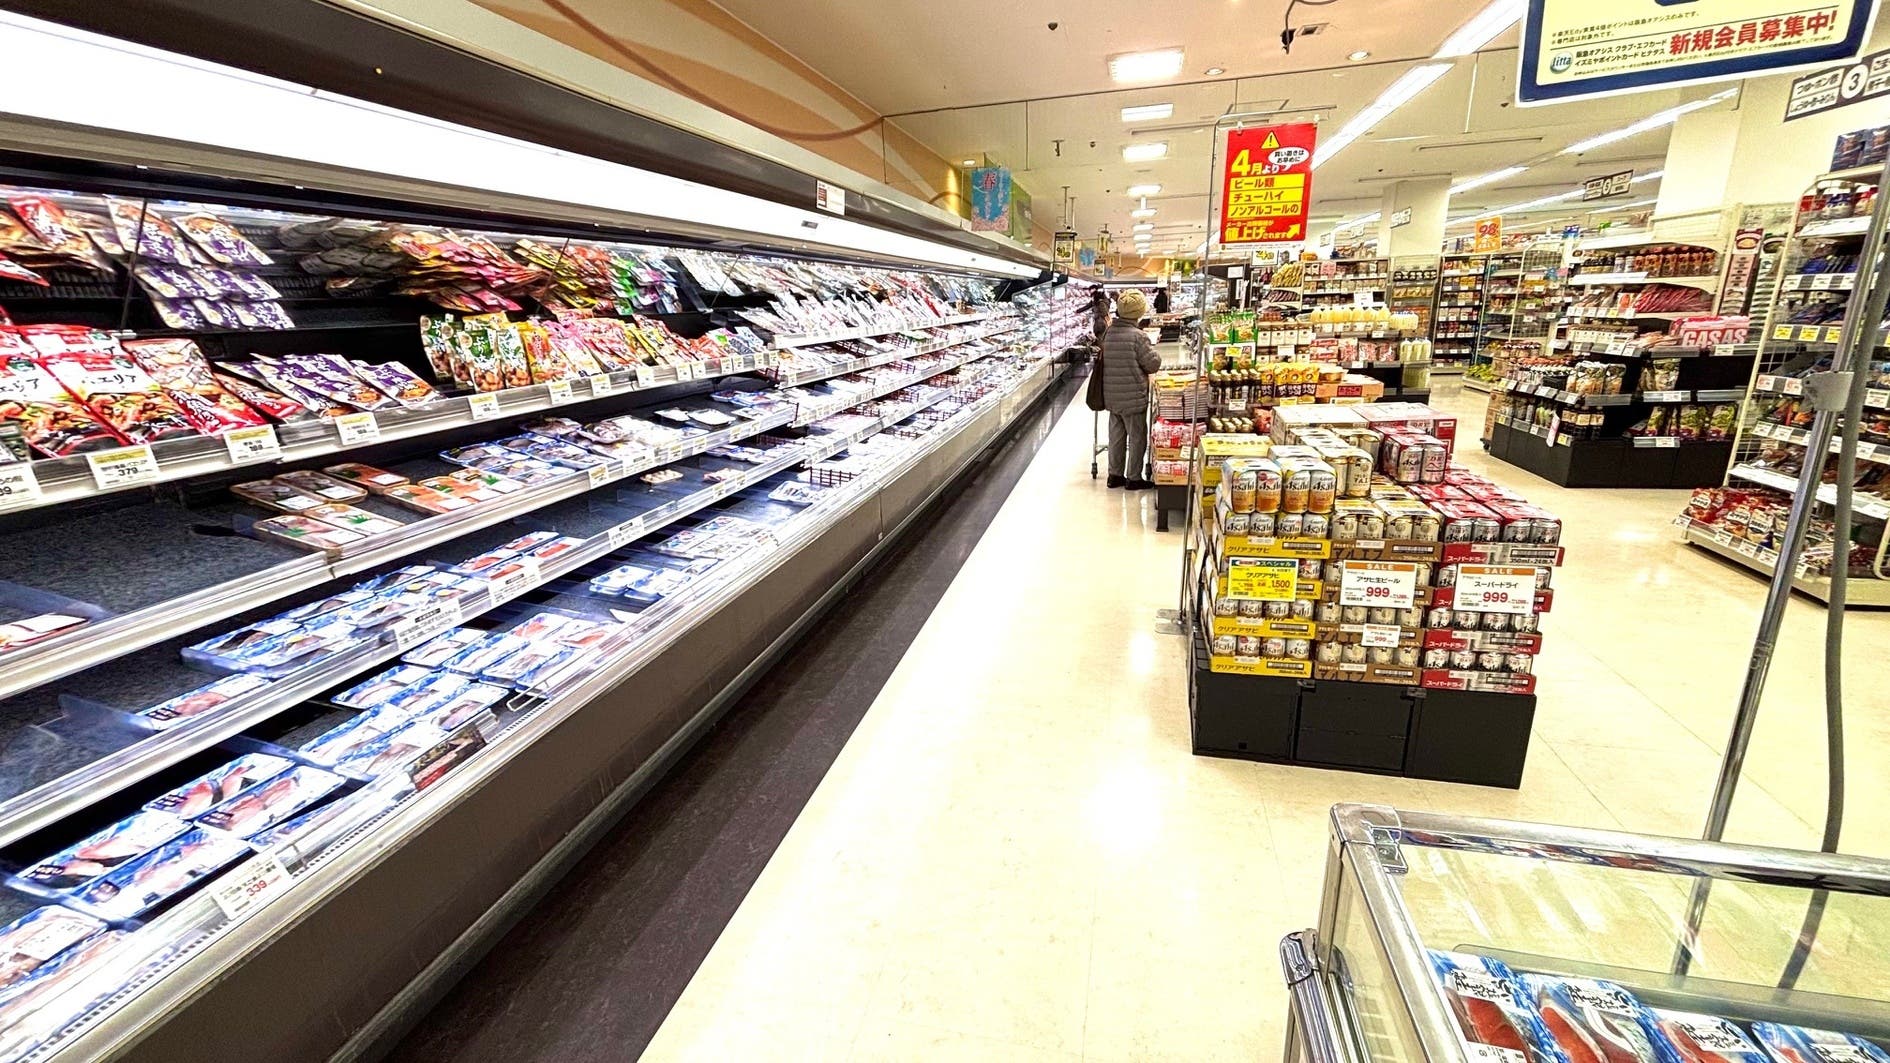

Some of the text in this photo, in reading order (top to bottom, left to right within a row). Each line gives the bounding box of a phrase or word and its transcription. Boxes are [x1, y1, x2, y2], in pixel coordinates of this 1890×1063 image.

[1669, 10, 1837, 55] 新規会員募集中!
[1848, 73, 1860, 91] 3
[1231, 149, 1280, 176] 4月より
[1234, 178, 1275, 189] ビール類
[1233, 191, 1284, 202] チューハイ
[1230, 204, 1299, 216] ノンアルコールの
[118, 467, 139, 477] 379
[1227, 545, 1270, 554] クリアアサヒ
[1483, 567, 1513, 575] SALE
[1356, 575, 1401, 584] アサヒ生ビール
[1474, 581, 1519, 589] スーパードライ
[1366, 586, 1390, 597] 999
[1482, 592, 1508, 603] 999
[246, 879, 267, 896] 339
